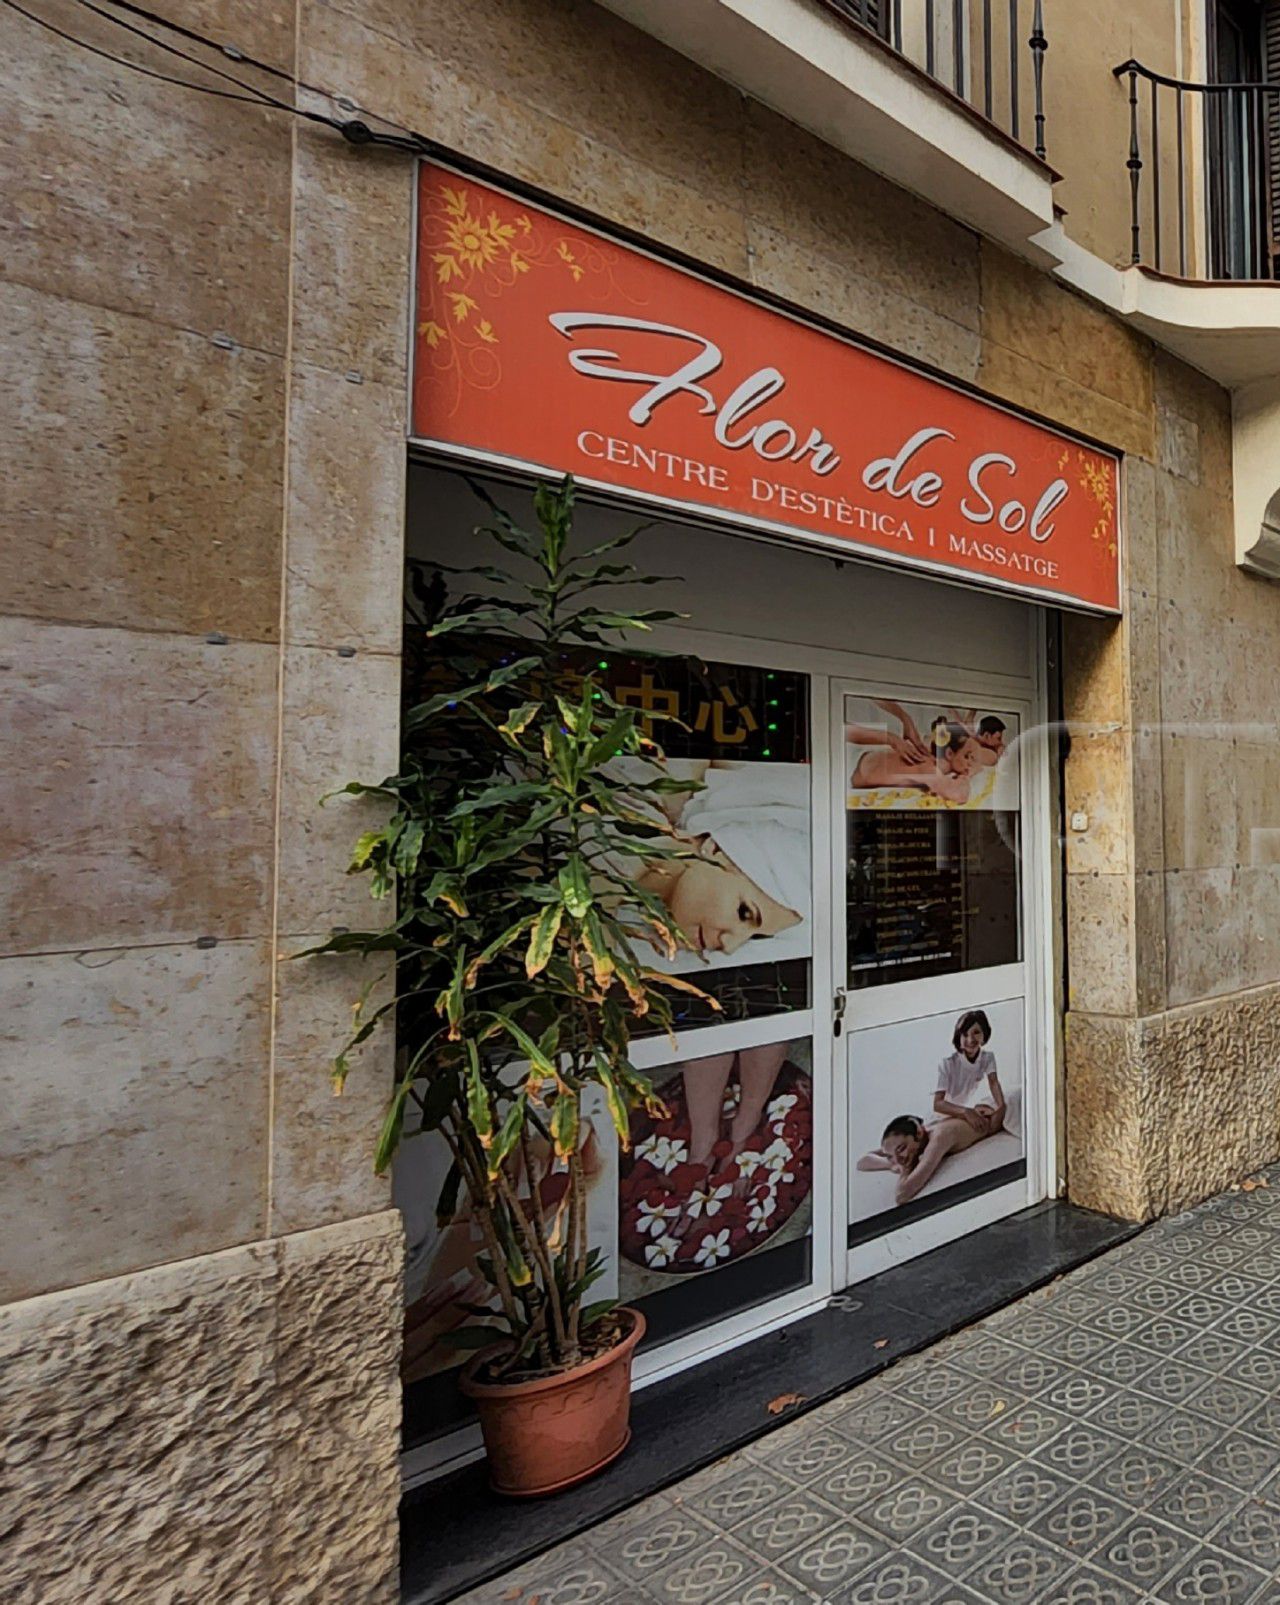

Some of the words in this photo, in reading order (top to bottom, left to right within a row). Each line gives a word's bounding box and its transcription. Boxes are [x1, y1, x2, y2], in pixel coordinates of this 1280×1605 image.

[548, 311, 841, 477] Flor
[861, 426, 956, 508] de
[960, 452, 1069, 543] Sol
[576, 430, 730, 491] CENTRE
[751, 477, 914, 542] D'ESTÈTICA
[928, 527, 935, 547] I
[949, 533, 1059, 579] MASSATGE
